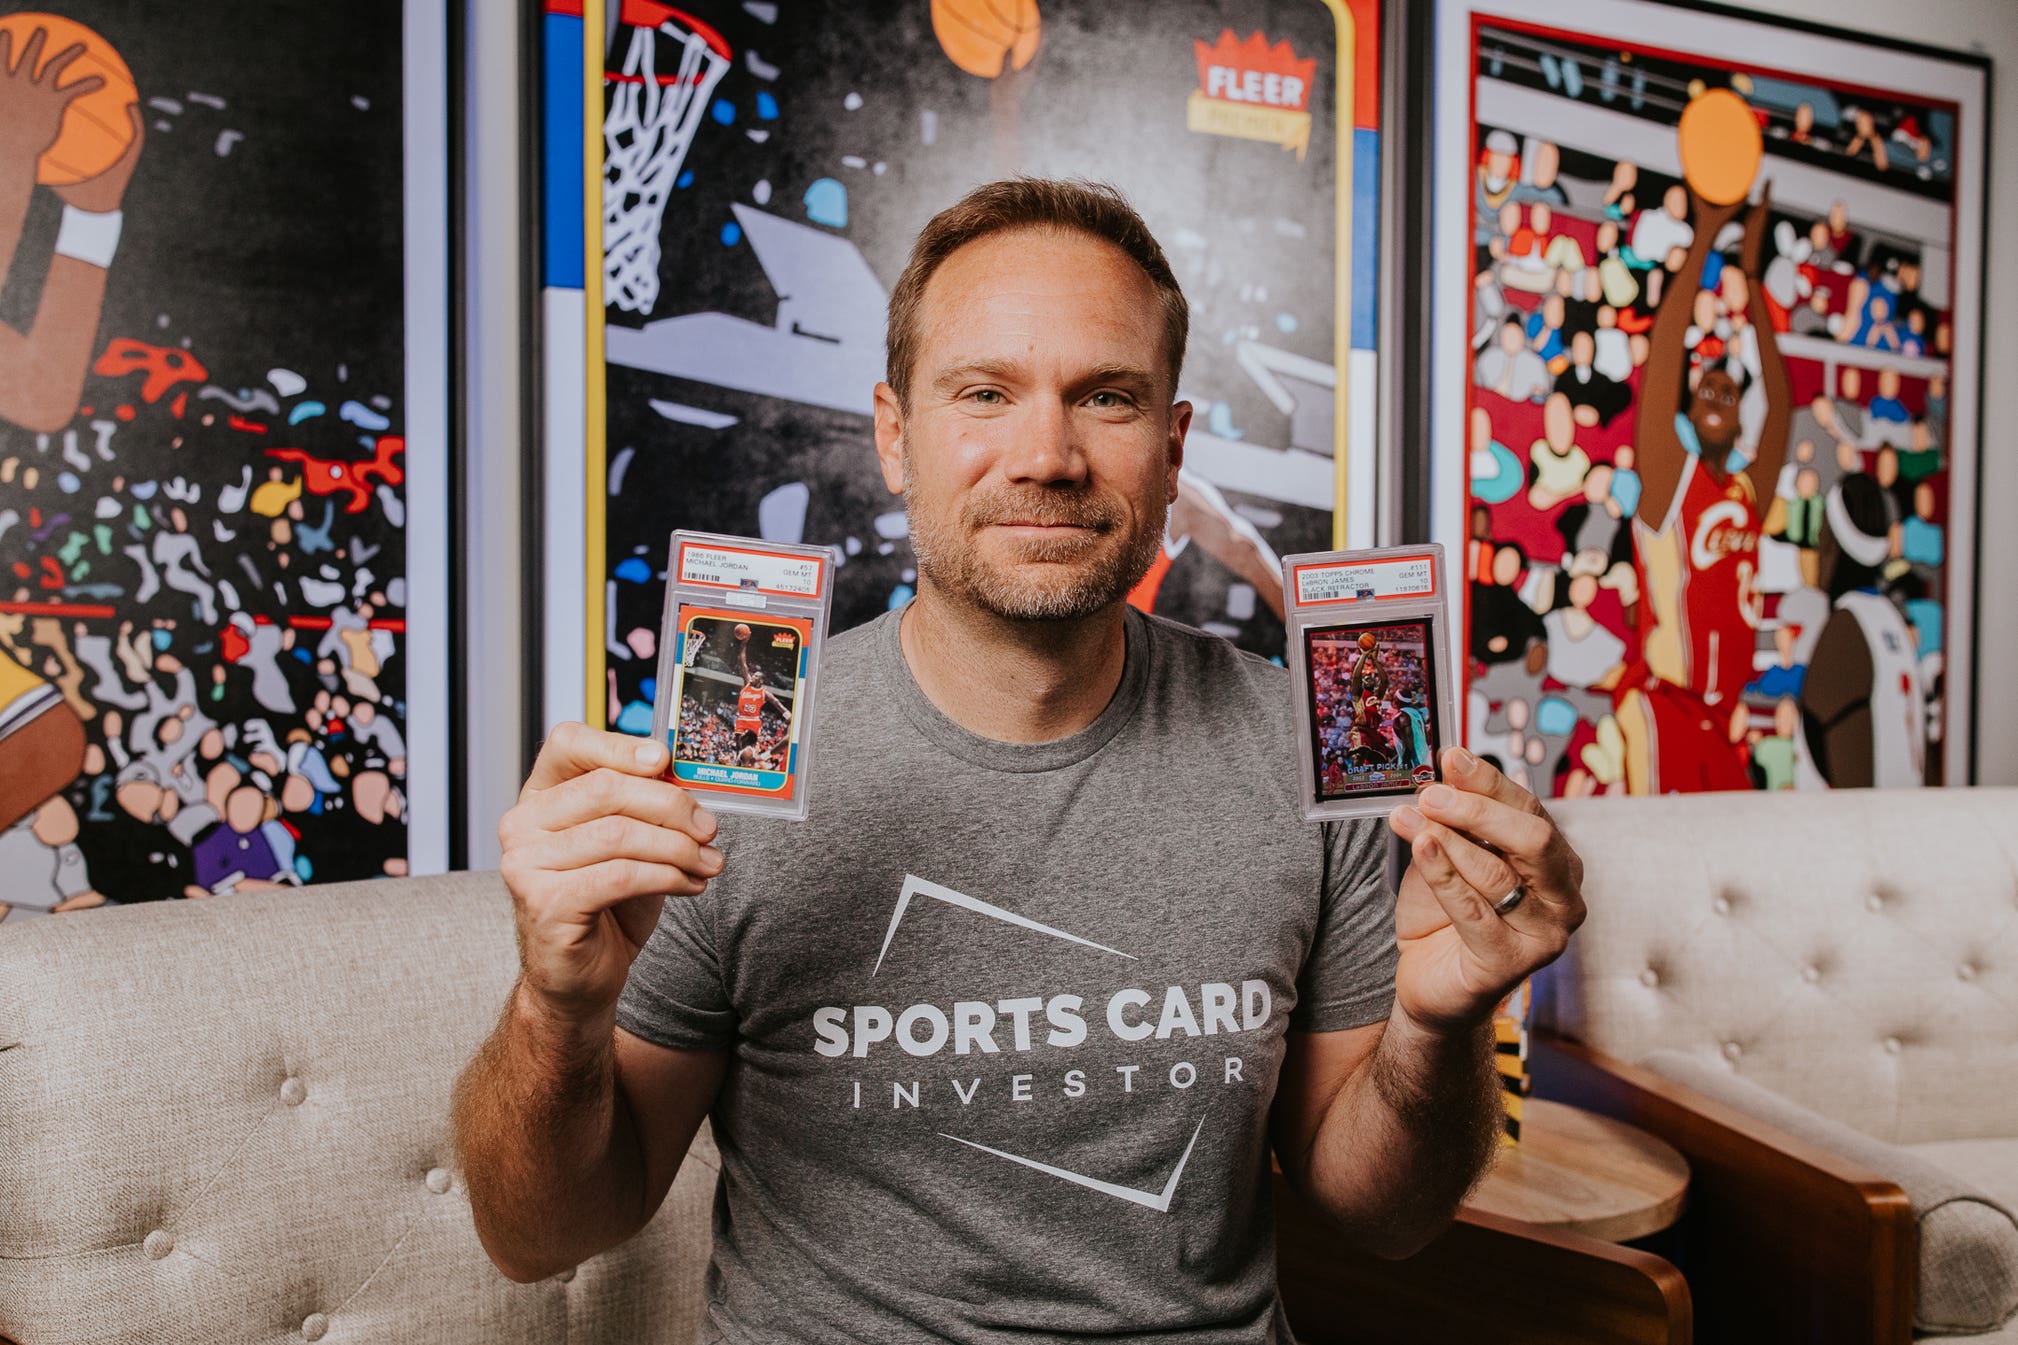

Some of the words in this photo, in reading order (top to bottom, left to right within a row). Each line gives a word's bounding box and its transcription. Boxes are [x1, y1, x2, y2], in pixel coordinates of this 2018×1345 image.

[1207, 65, 1304, 107] FLEER
[687, 551, 705, 559] 1986
[706, 553, 727, 561] FLEER
[686, 557, 716, 568] MICHAEL
[719, 562, 749, 571] JORDAN
[783, 568, 799, 577] GEM
[1345, 568, 1374, 577] CHROME
[1331, 576, 1354, 585] JAMES
[1327, 582, 1370, 592] REFRACTOR
[697, 767, 727, 777] MICHAEL
[731, 771, 759, 781] JORDAN
[1347, 763, 1374, 775] DRAFT
[1376, 763, 1396, 771] PICK
[812, 993, 1088, 1058] SPORTS
[1106, 978, 1273, 1042] CARD
[853, 1056, 1245, 1109] INVESTOR
